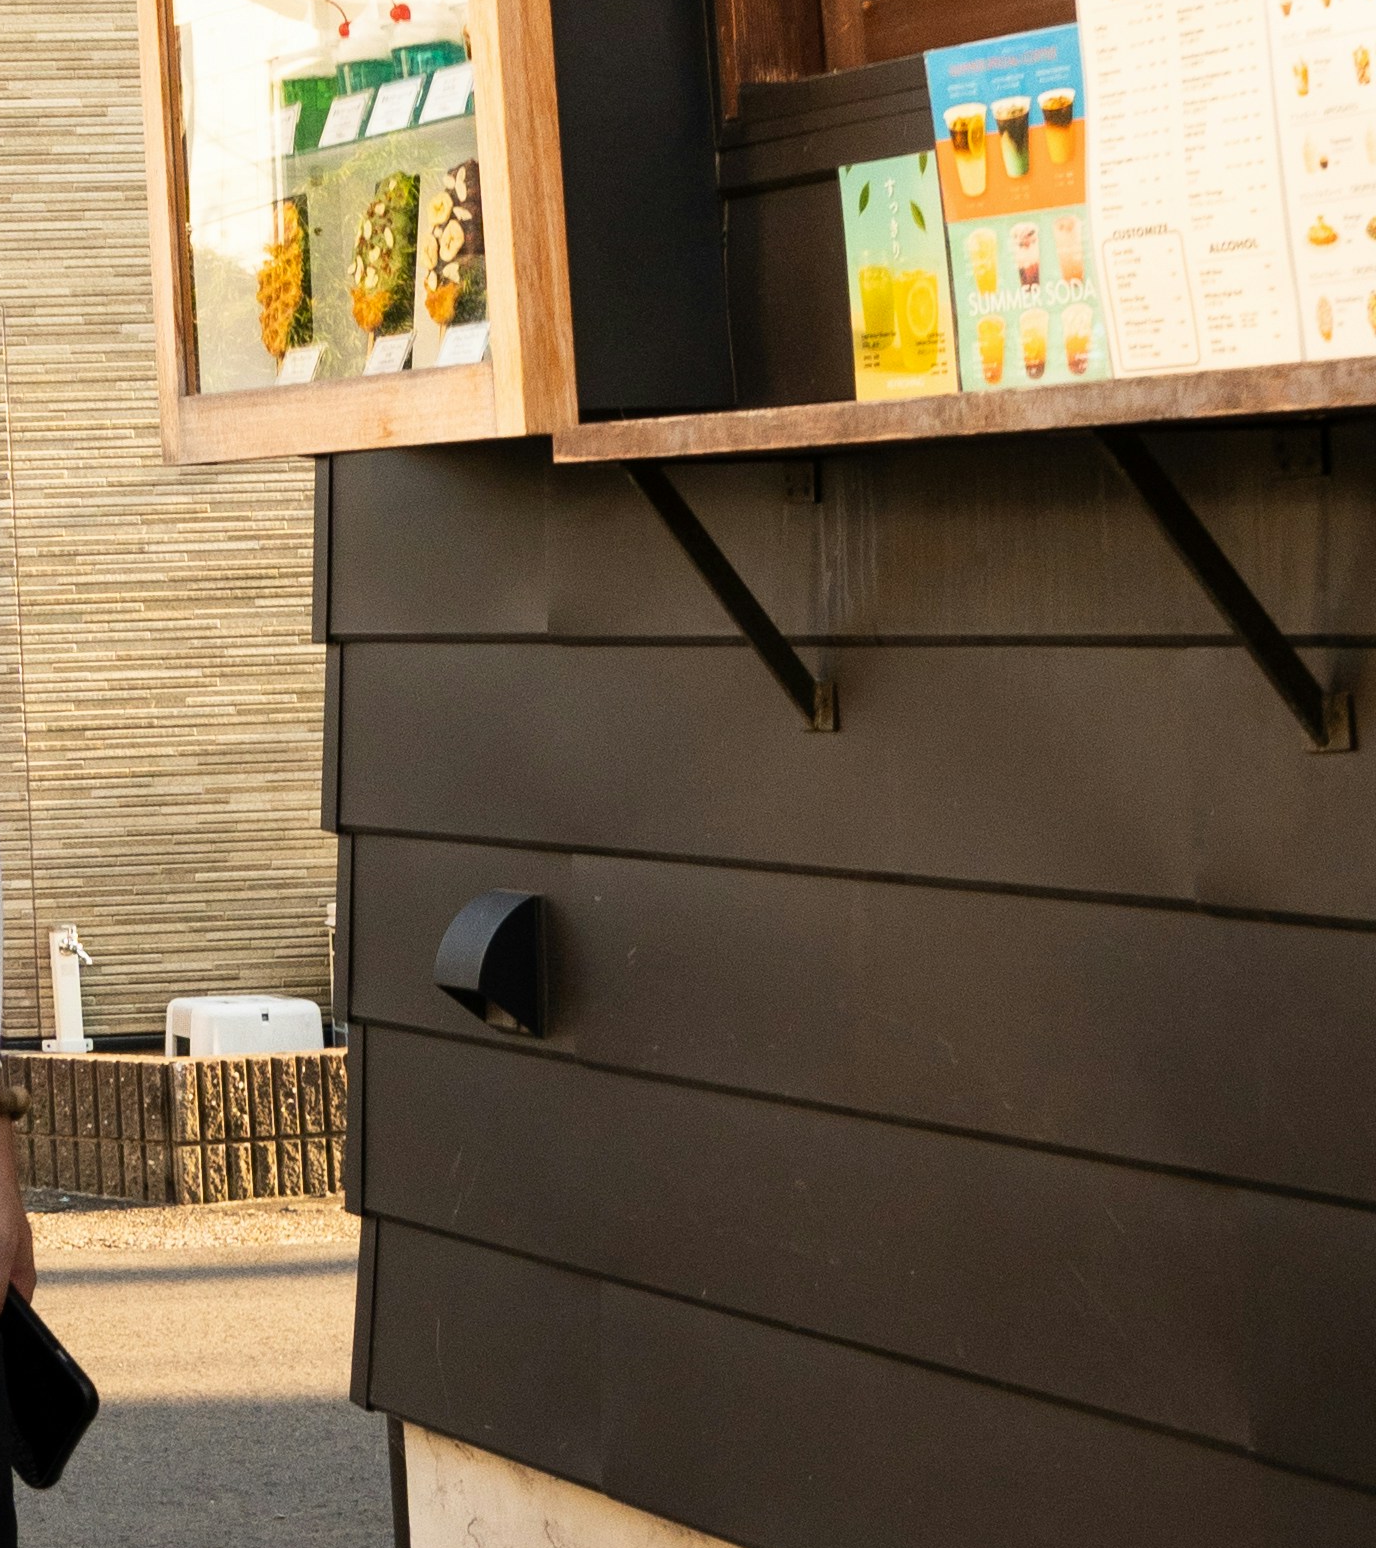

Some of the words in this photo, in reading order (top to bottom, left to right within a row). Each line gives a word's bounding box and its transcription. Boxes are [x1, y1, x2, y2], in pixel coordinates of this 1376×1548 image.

[883, 177, 903, 261] すっきり
[1112, 223, 1169, 241] CUSTOMIZE
[1208, 237, 1260, 254] ALCOHOL
[967, 285, 1043, 317] SUMMER
[1044, 278, 1098, 307] SODA
